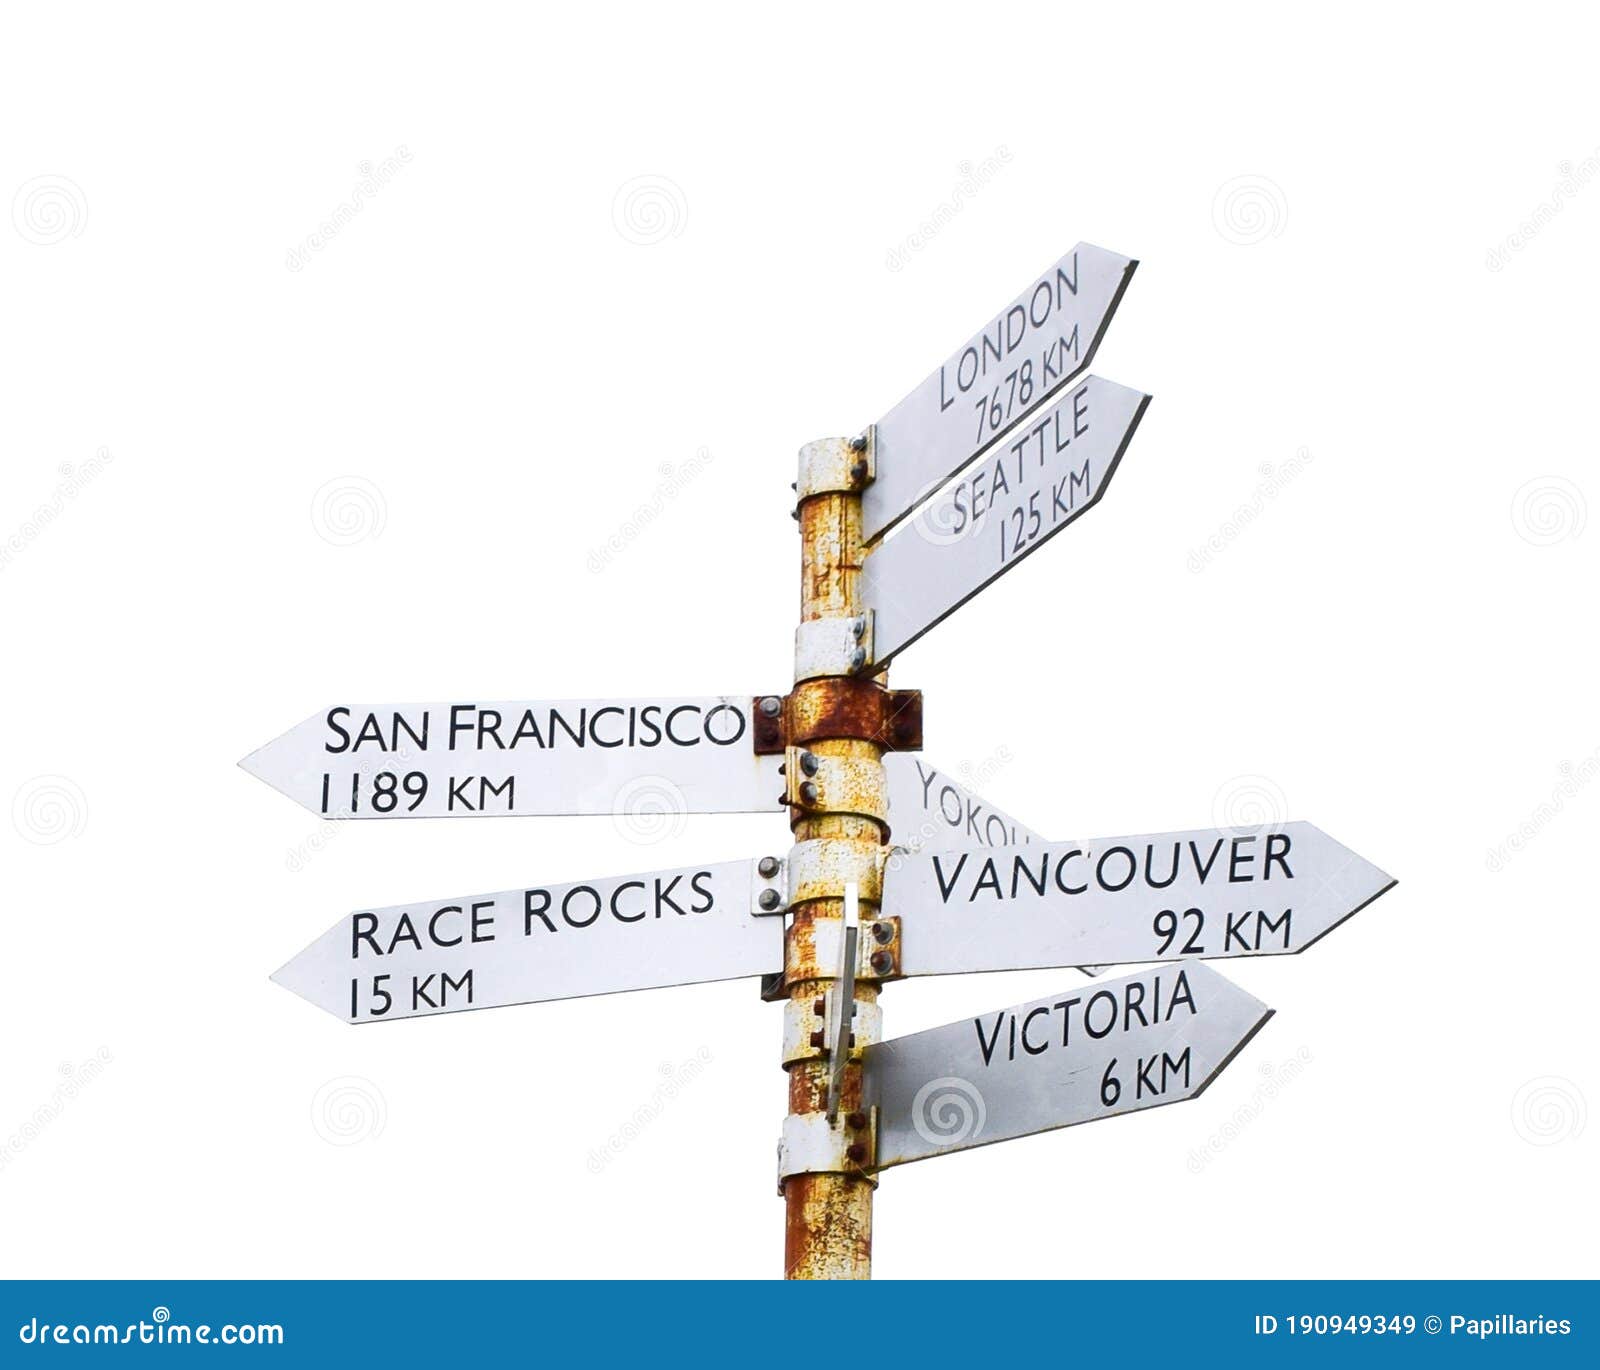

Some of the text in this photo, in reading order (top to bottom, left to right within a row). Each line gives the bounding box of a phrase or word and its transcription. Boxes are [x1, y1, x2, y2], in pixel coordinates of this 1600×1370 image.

[937, 252, 1079, 413] LONDON
[974, 322, 1080, 444] 7678 KM
[952, 385, 1090, 535] SEATTLE
[999, 458, 1091, 563] 125 KM
[325, 704, 746, 753] SAN FRANCISCO
[321, 771, 515, 814] 1189 KM
[931, 833, 1296, 903] VANCOUVER
[351, 871, 714, 958] RACE ROCKS
[1152, 908, 1293, 955] 92 KM
[350, 968, 475, 1018] 15 KM
[974, 970, 1198, 1066] VICTORIA
[1100, 1046, 1192, 1107] 6 KM
